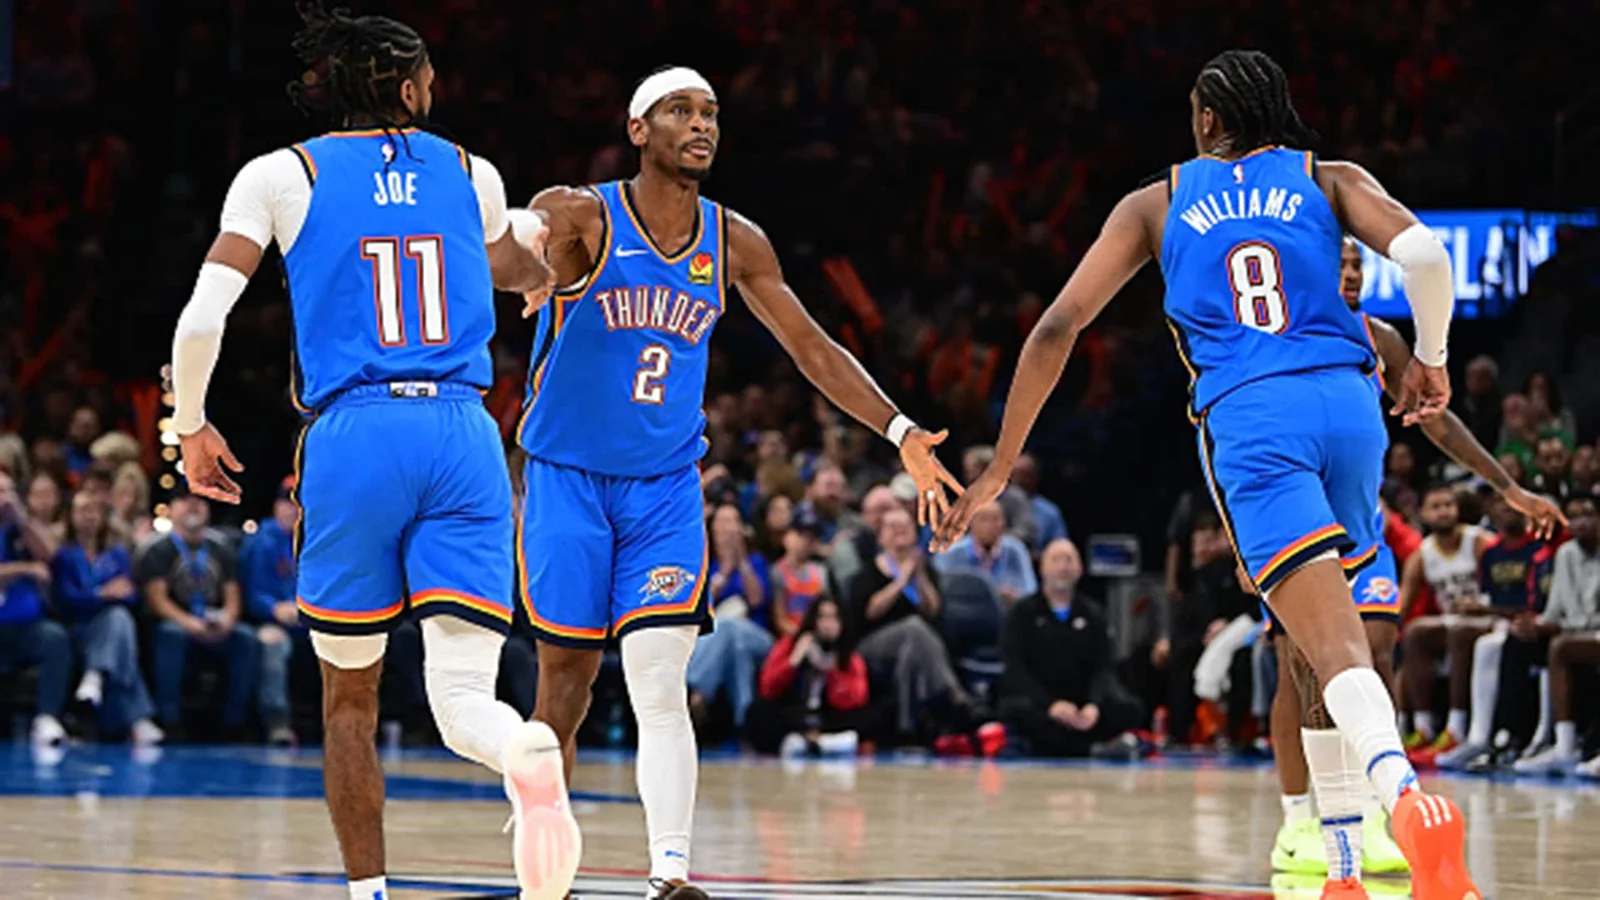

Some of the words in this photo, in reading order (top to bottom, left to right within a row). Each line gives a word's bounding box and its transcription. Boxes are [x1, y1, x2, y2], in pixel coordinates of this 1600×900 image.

[374, 171, 418, 205] JOE
[1180, 187, 1303, 235] WILLIAMS
[360, 235, 450, 347] 11
[594, 285, 720, 346] THUNDER
[1225, 240, 1290, 335] 8
[631, 343, 672, 405] 2
